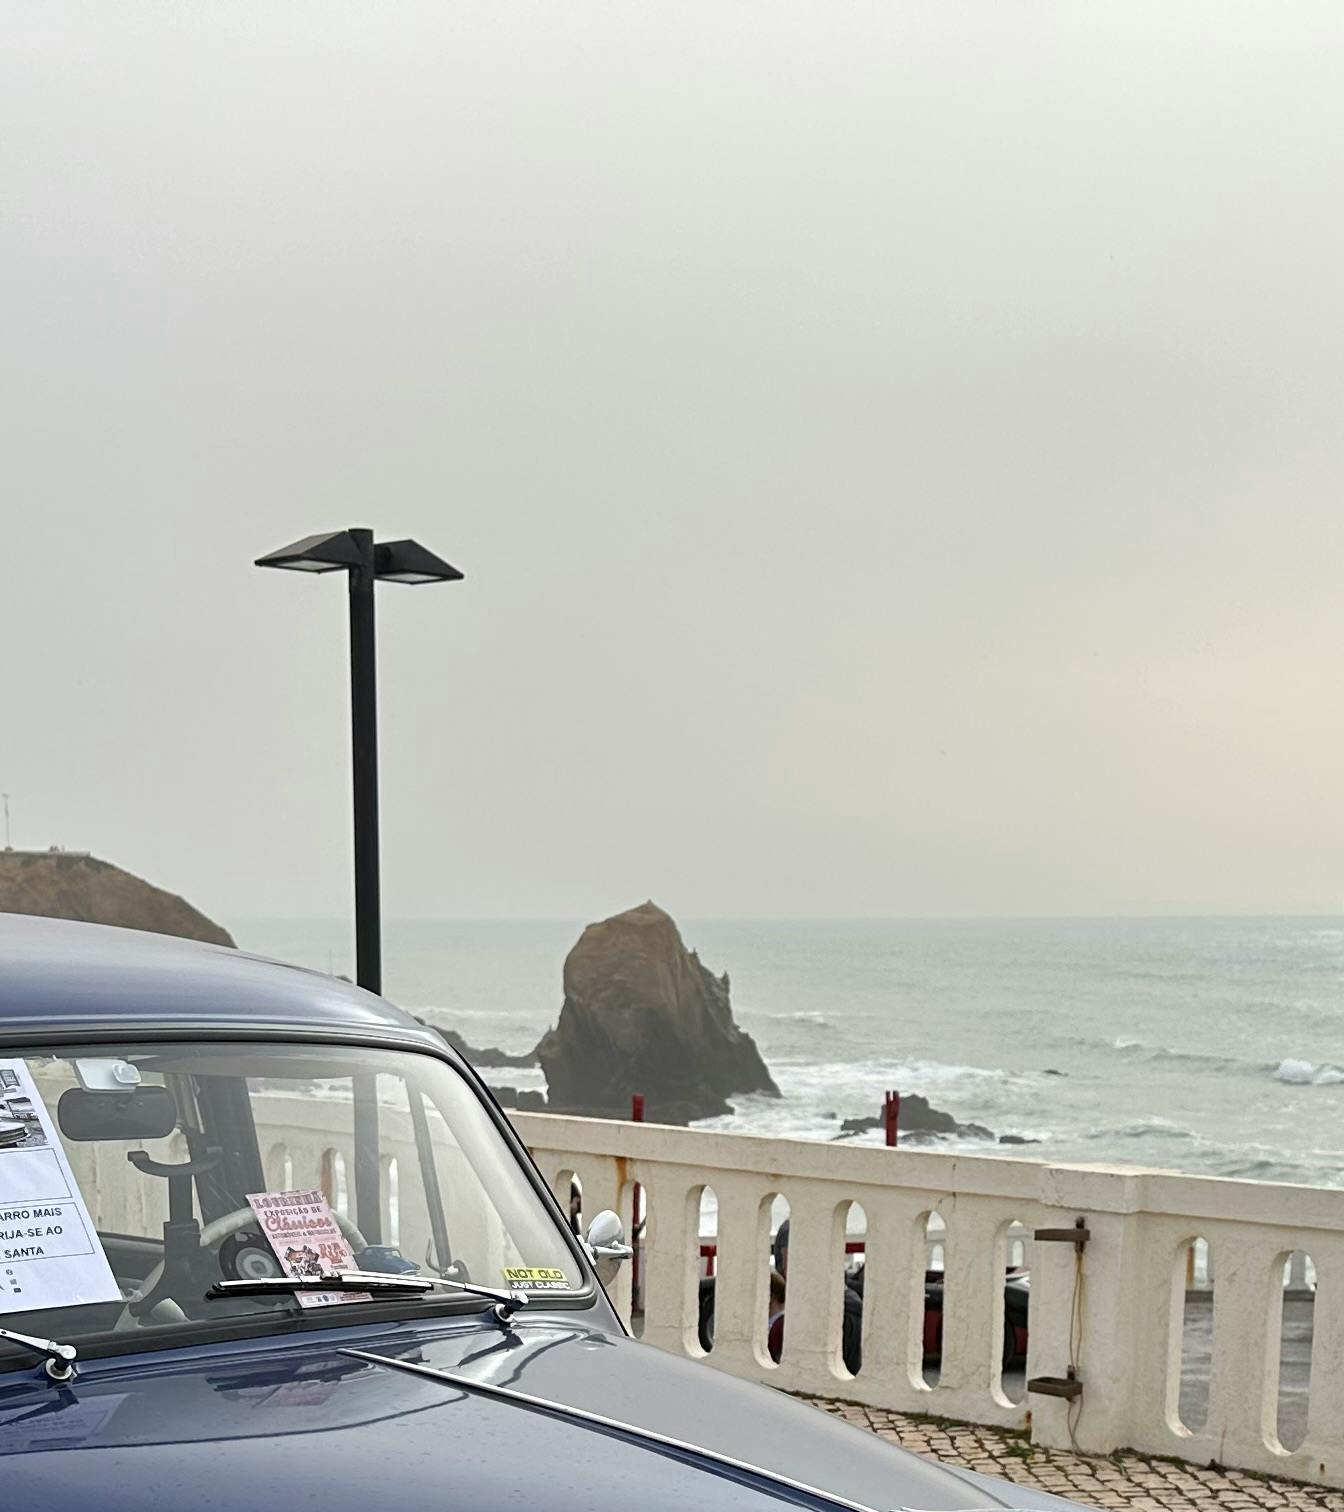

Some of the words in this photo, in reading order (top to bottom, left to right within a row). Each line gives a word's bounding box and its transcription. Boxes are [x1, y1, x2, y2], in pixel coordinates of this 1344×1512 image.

[33, 1207, 63, 1218] MAIS
[311, 1205, 323, 1214] DE
[45, 1225, 64, 1236] AO
[4, 1246, 45, 1260] SANTA
[506, 1268, 533, 1279] NOT
[537, 1269, 564, 1279] OLD
[511, 1280, 533, 1289] JUST
